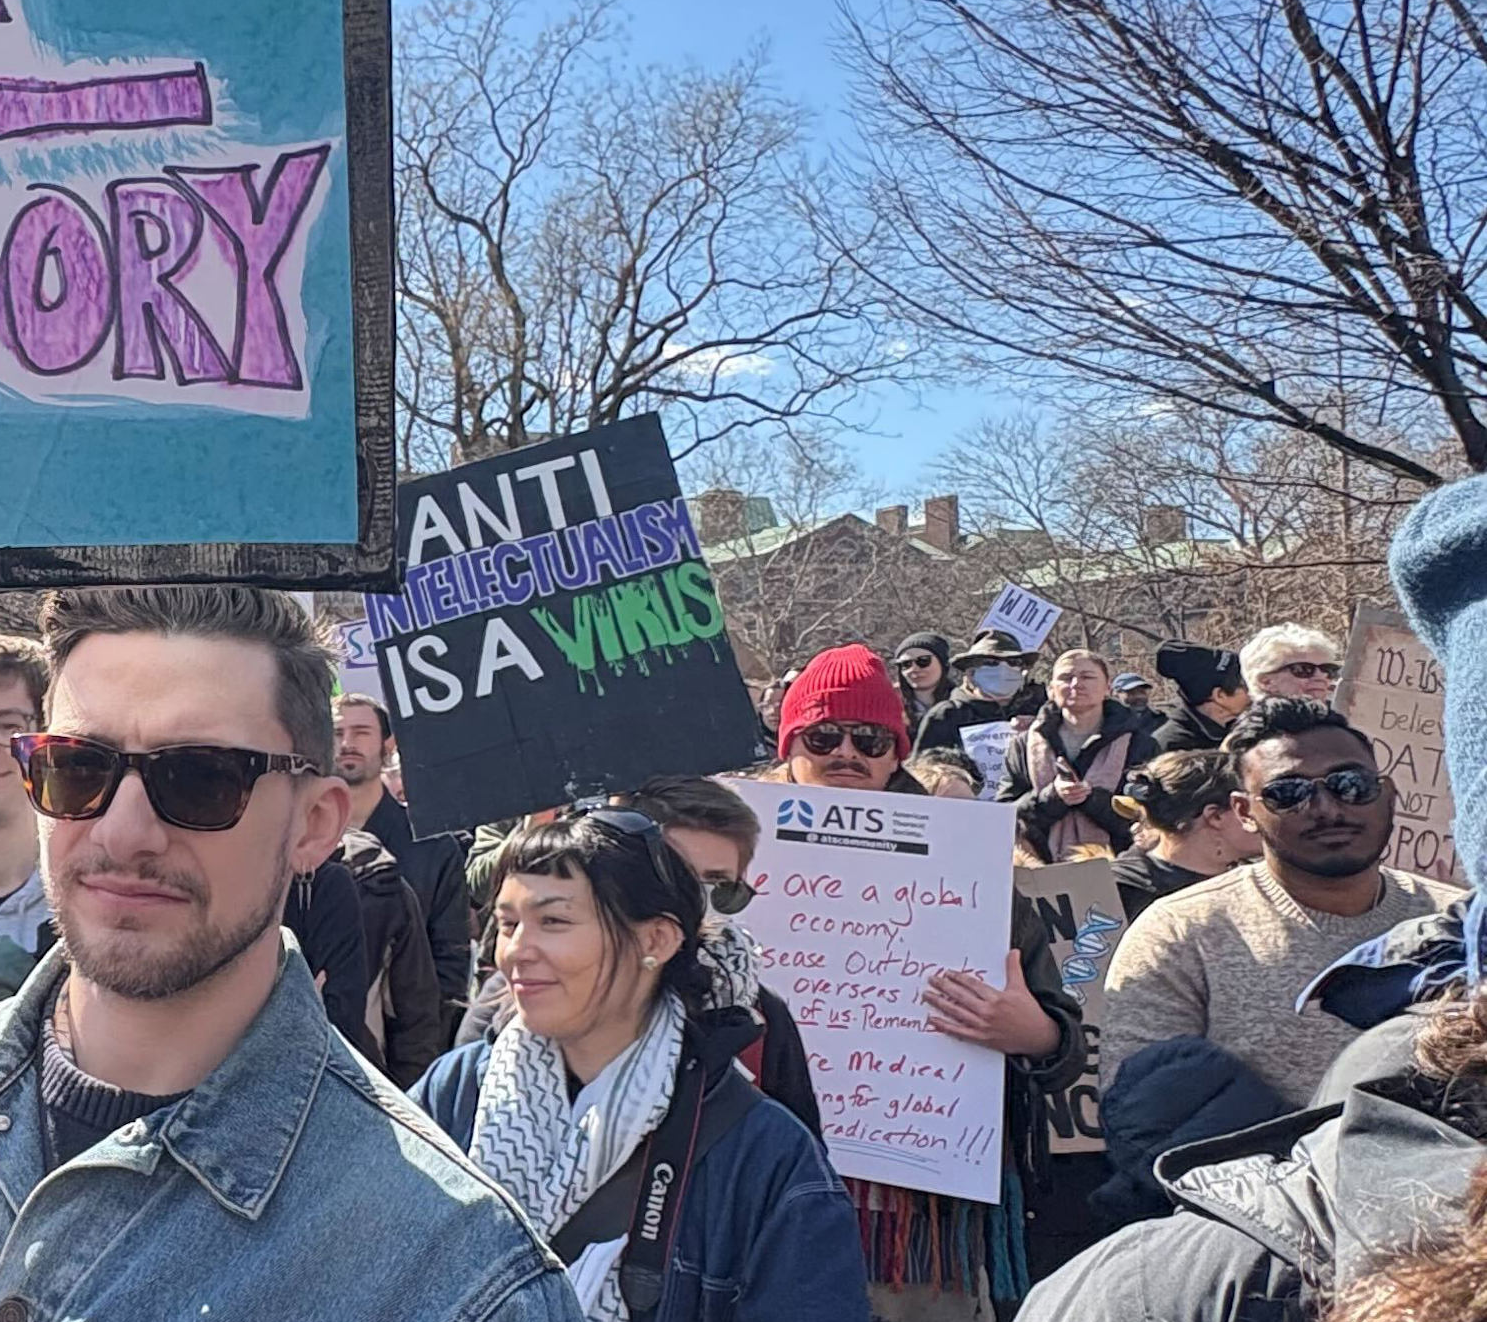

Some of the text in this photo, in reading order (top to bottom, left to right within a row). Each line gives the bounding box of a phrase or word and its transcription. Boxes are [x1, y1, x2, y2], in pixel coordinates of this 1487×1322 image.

[408, 449, 612, 566] ANTI
[362, 496, 704, 641] INTELLECTUALISM
[385, 563, 726, 718] IS A VIRUS
[1380, 697, 1444, 737] believ
[1371, 738, 1445, 786] DAT
[821, 805, 884, 833] ATS
[1396, 792, 1438, 814] NOT
[754, 873, 977, 927] e are a global
[763, 948, 826, 968] sease
[794, 978, 901, 1003] overseas
[799, 998, 826, 1020] of
[861, 1003, 939, 1033] Rememb
[848, 1051, 965, 1083] Medical
[883, 1093, 960, 1119] global
[822, 1119, 947, 1149] radication
[640, 1162, 674, 1241] Canon
